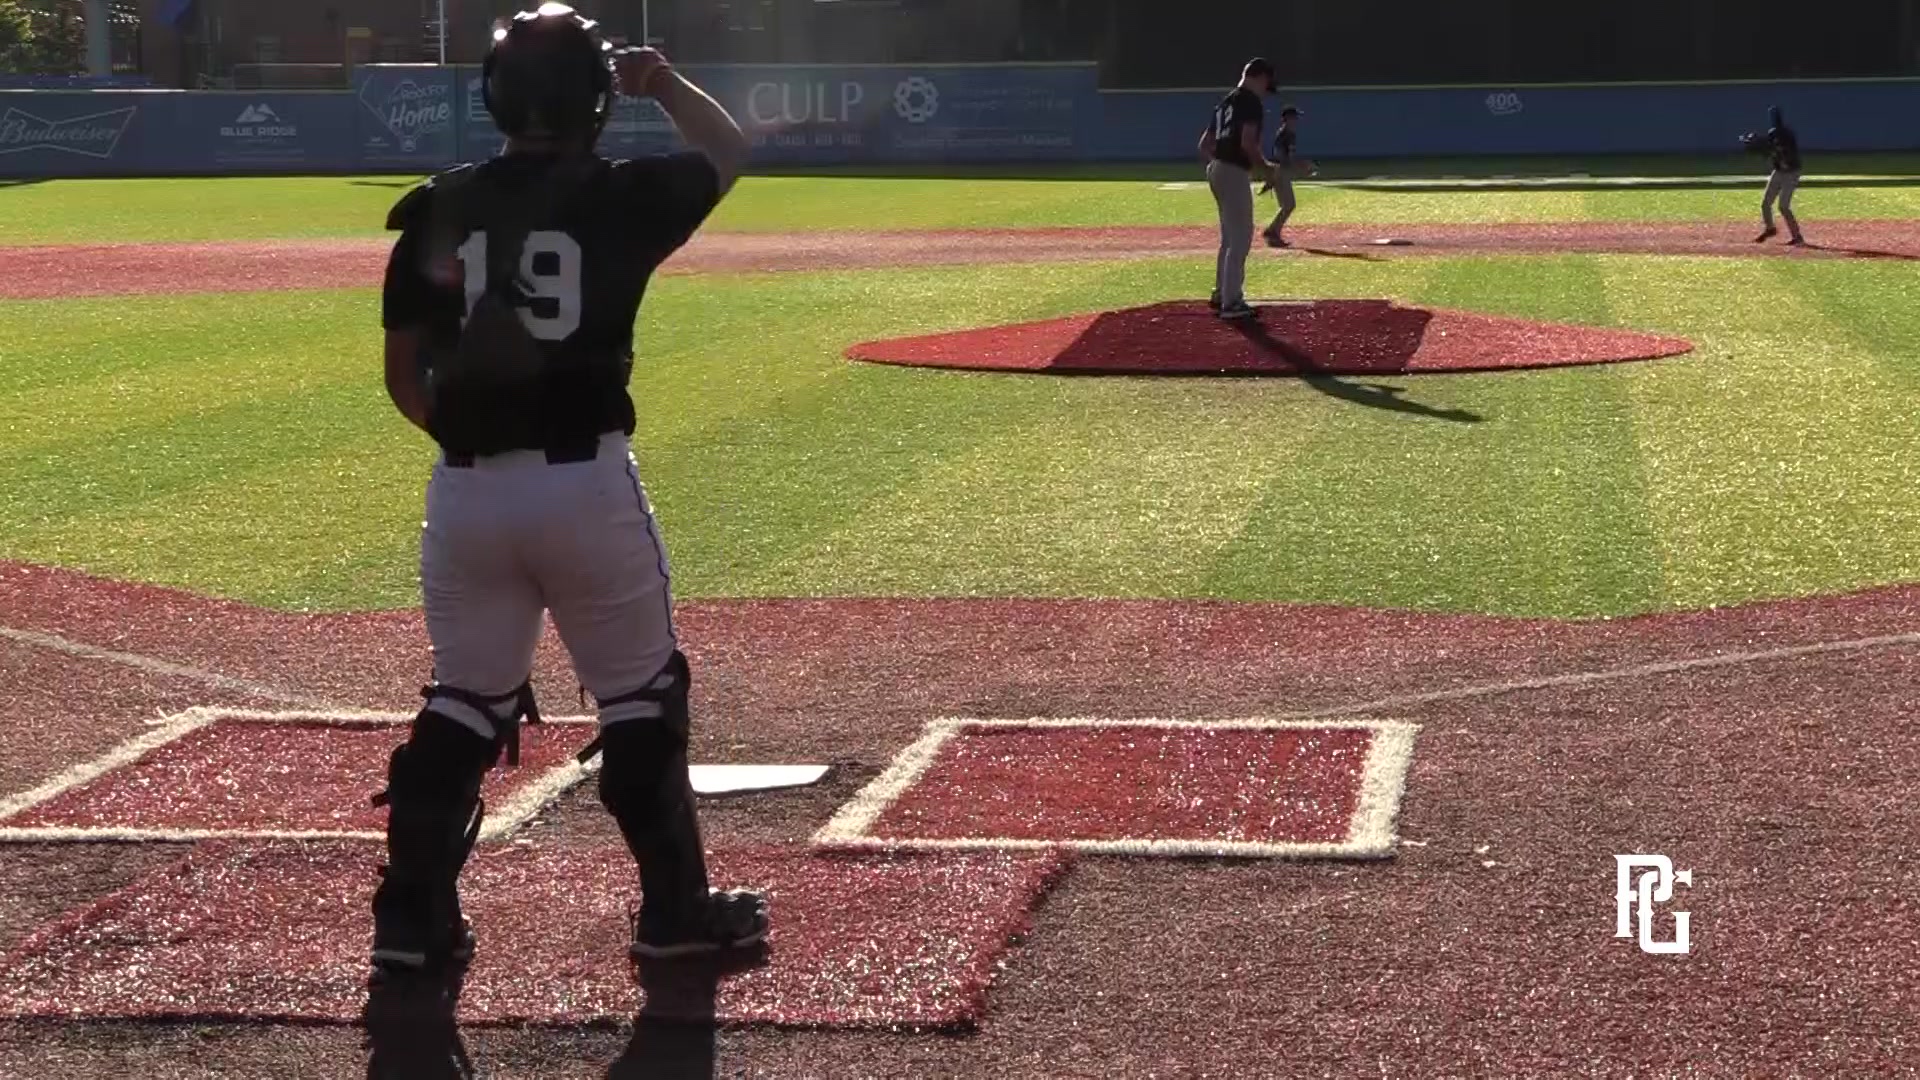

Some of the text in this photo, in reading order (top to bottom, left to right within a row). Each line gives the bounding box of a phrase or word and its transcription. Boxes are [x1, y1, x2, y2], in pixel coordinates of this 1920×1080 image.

[389, 102, 450, 130] Home
[748, 81, 864, 124] CULP
[0, 119, 119, 143] Budweiser
[220, 126, 297, 136] BLUE RIDGE
[454, 230, 582, 341] 19
